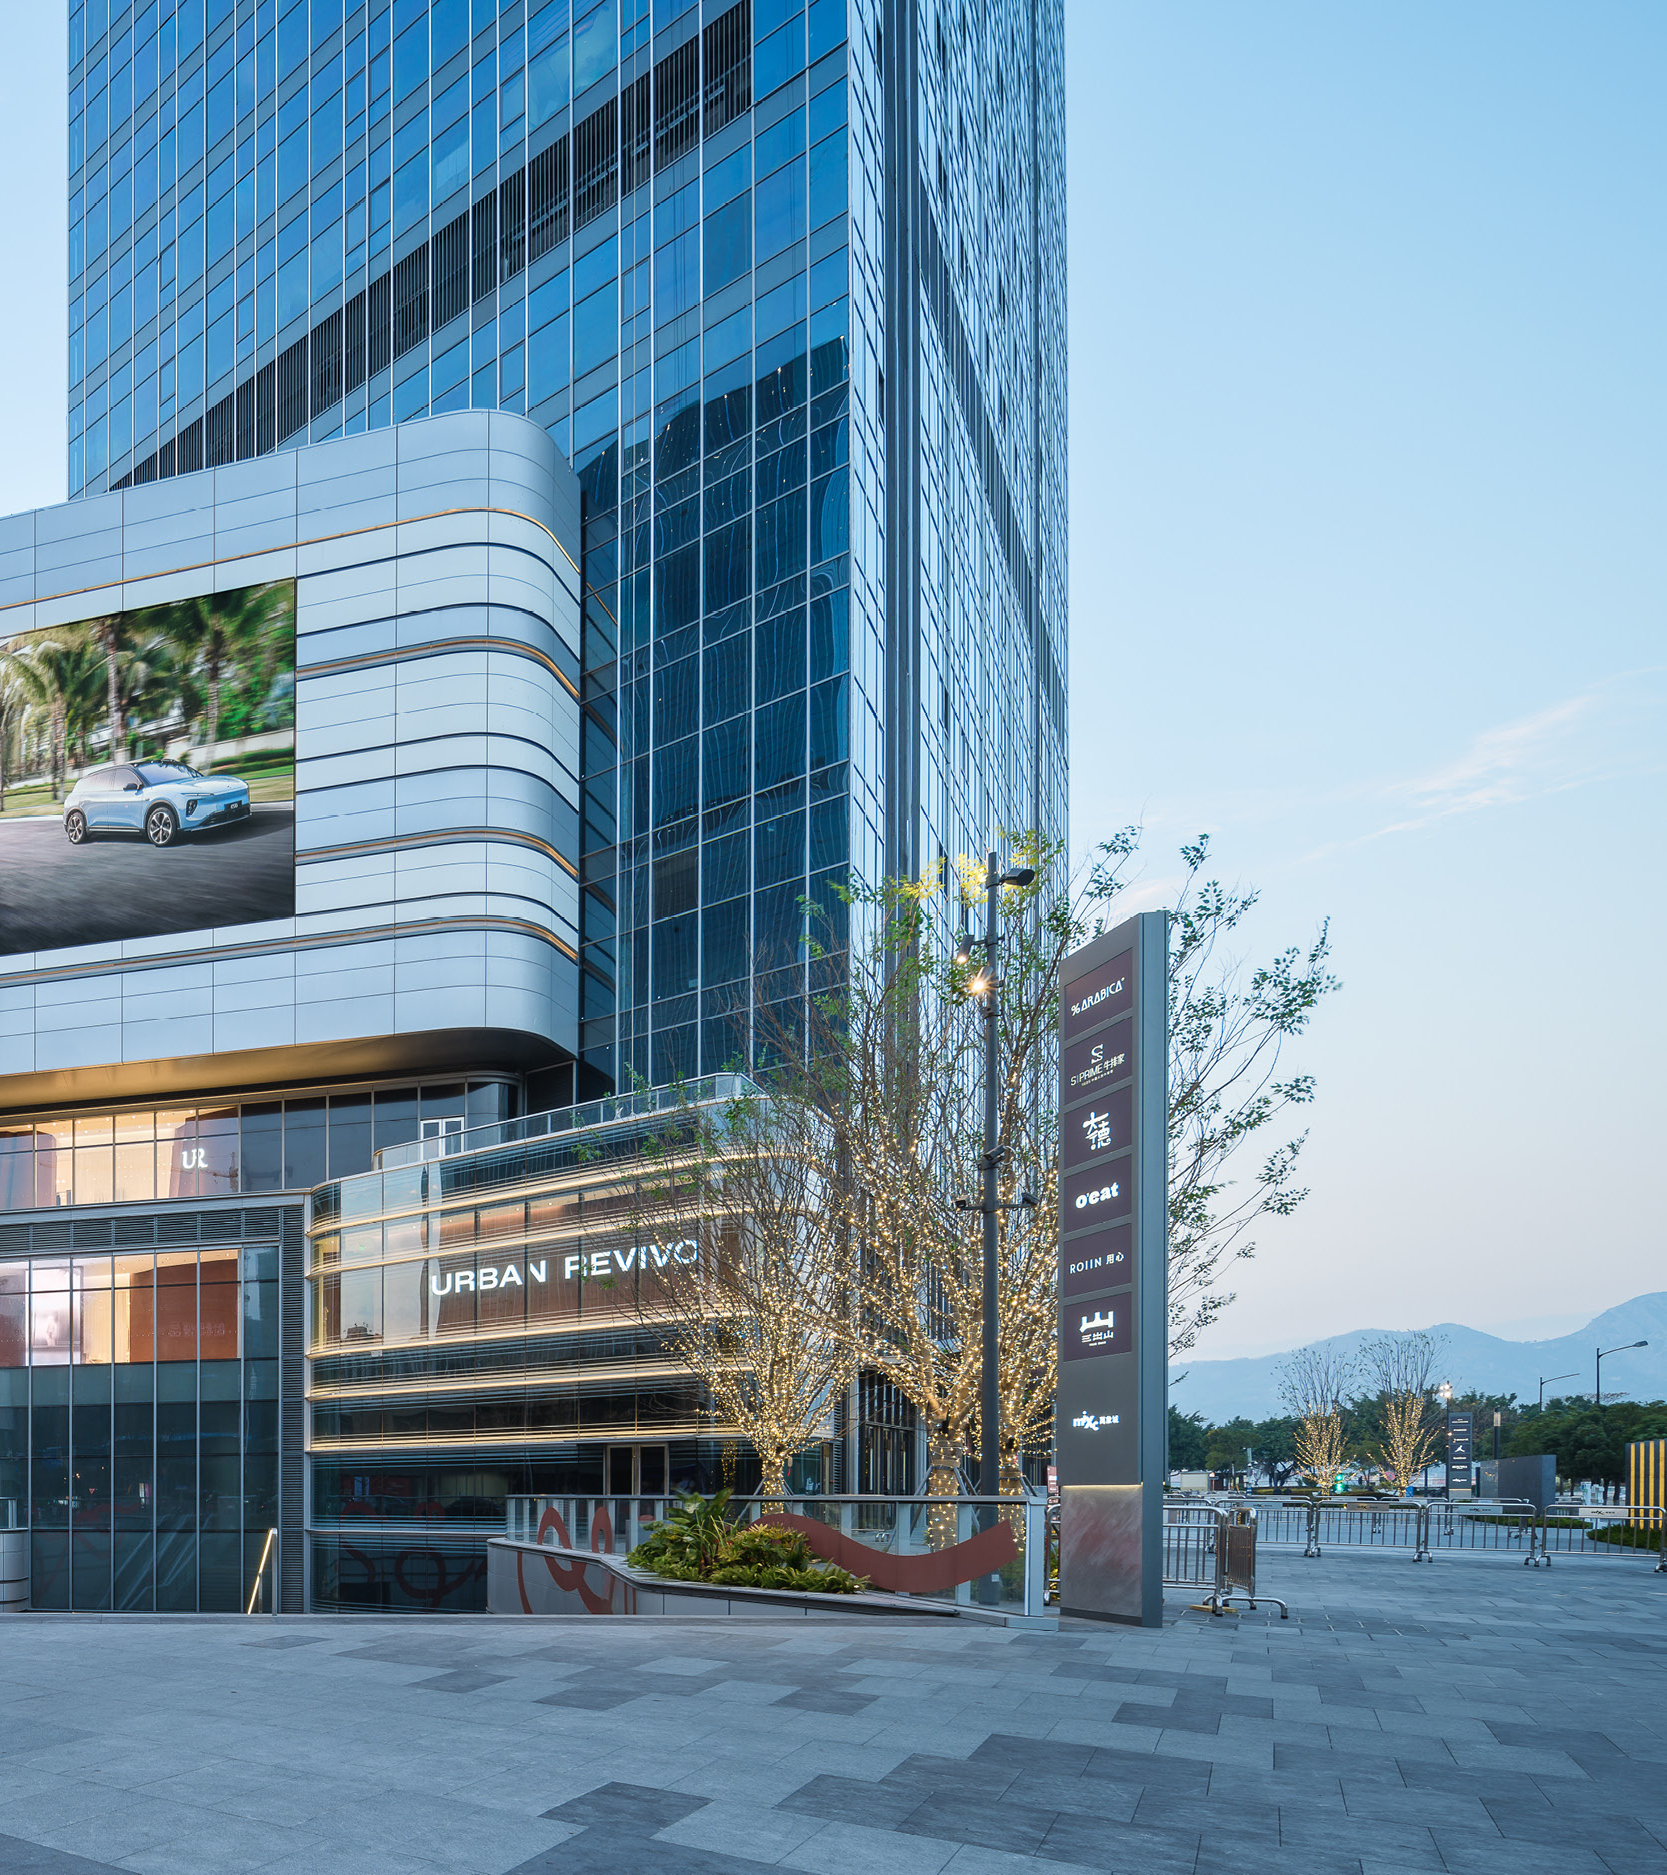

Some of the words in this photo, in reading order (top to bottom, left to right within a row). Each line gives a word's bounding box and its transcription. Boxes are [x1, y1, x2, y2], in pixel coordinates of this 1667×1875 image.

[181, 1147, 209, 1169] UR
[431, 1259, 547, 1296] URBAN
[564, 1239, 699, 1281] REVIVO
[1069, 1256, 1103, 1275] ROIIN
[1106, 1251, 1125, 1265] 用心
